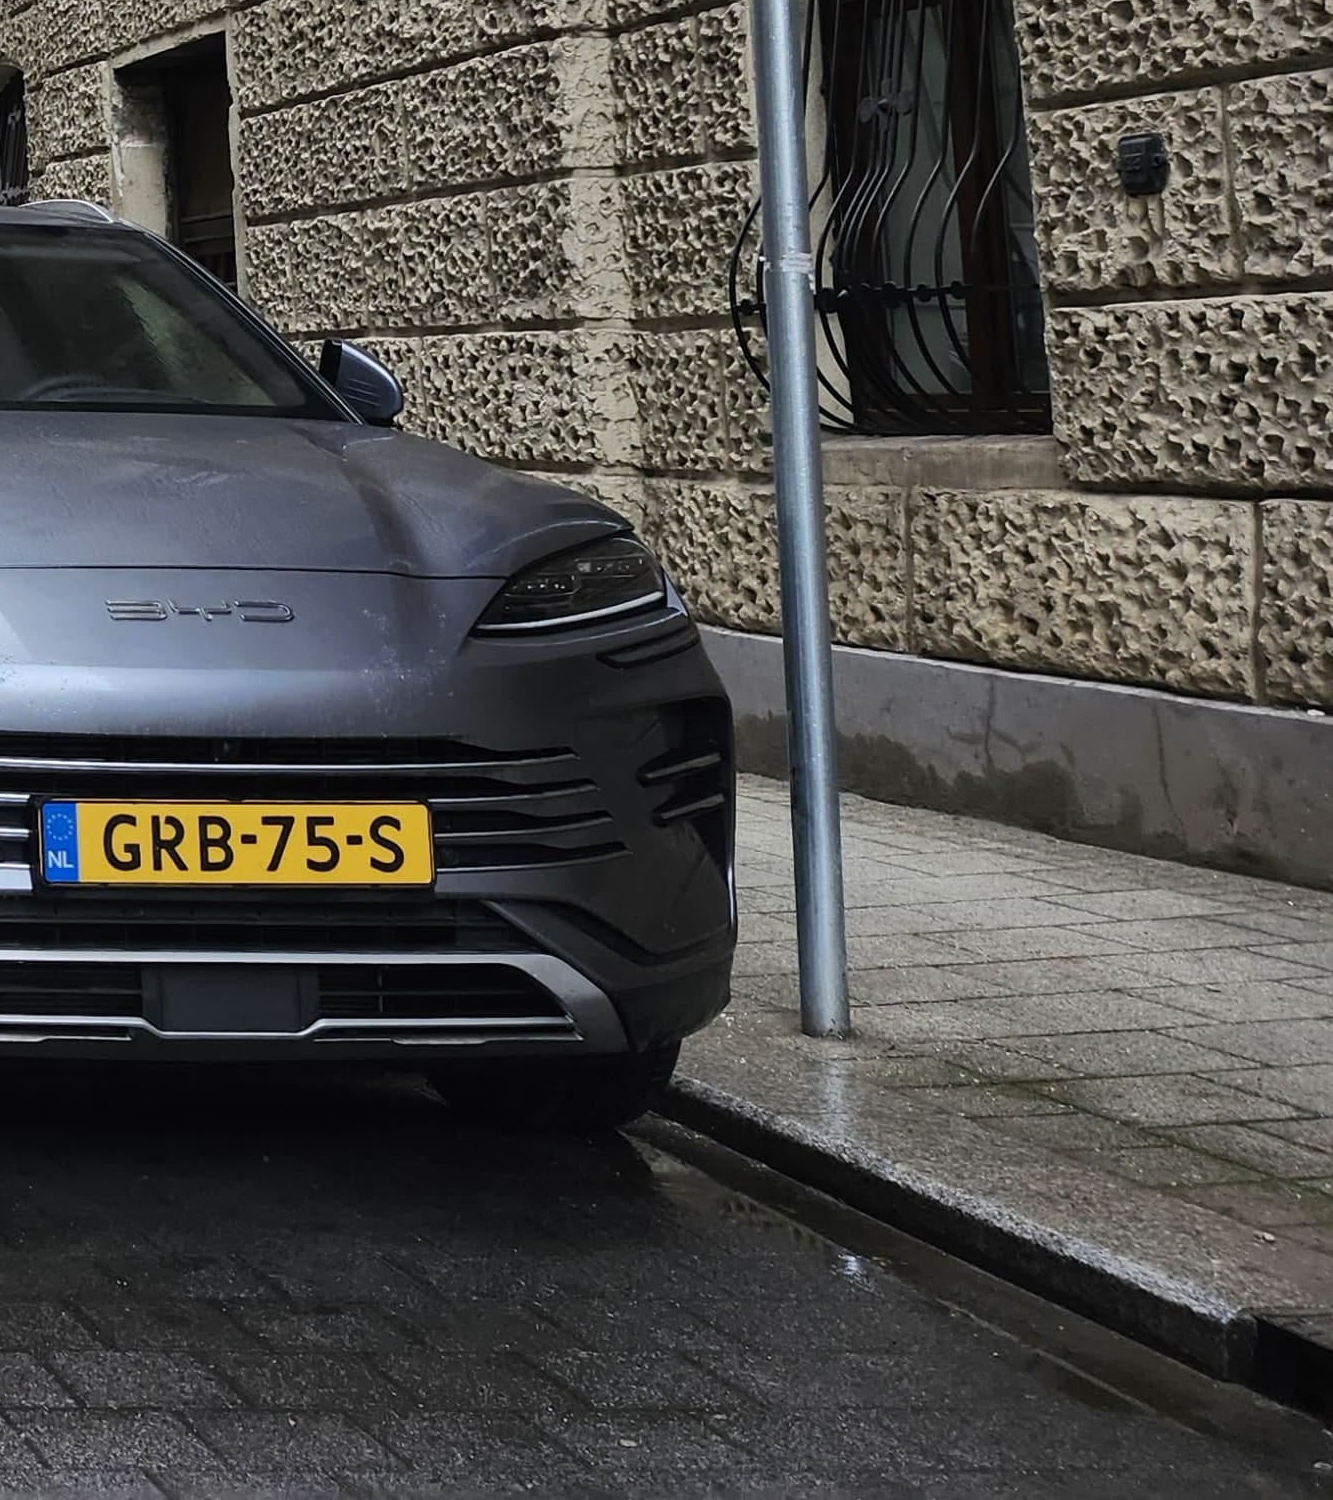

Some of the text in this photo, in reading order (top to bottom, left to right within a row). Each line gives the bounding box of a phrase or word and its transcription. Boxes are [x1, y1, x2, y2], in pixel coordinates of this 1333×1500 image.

[105, 599, 295, 622] BYD
[102, 814, 405, 873] GRB-75-S
[47, 850, 74, 870] NL
